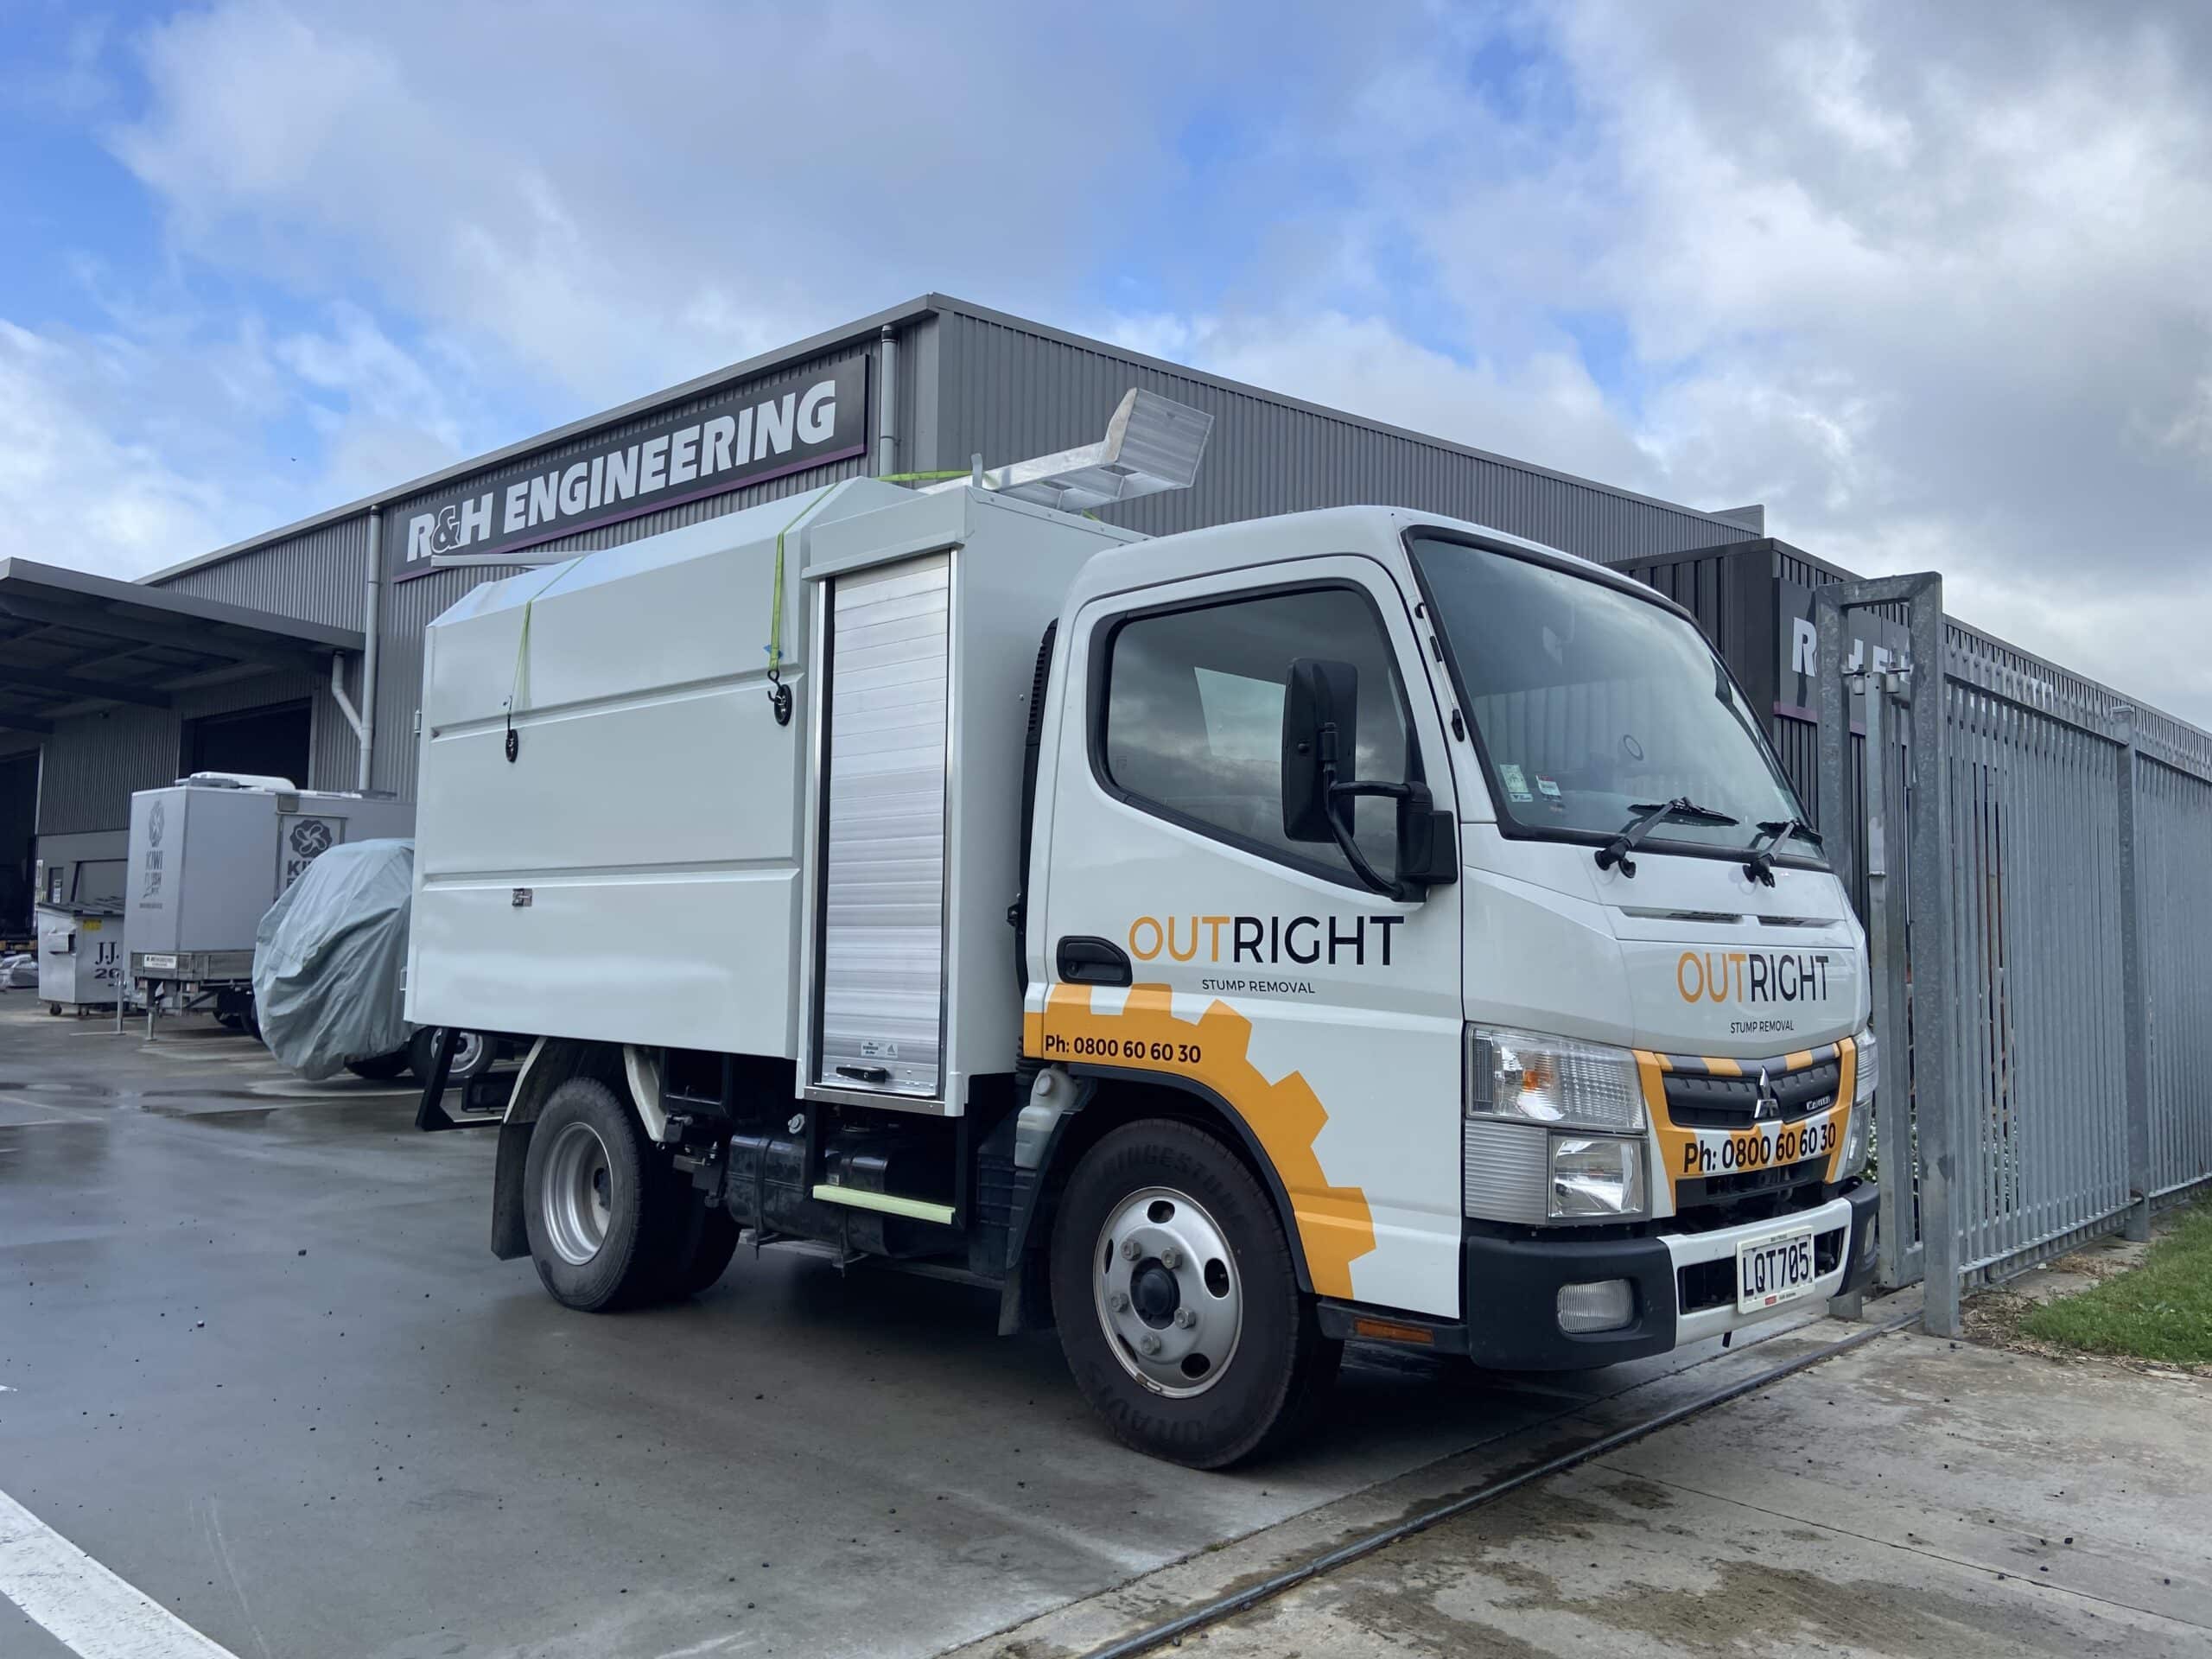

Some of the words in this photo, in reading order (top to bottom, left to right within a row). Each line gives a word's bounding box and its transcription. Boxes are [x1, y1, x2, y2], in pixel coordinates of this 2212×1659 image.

[406, 492, 494, 563] R&H
[503, 379, 836, 533] ENGINEERING
[145, 850, 163, 870] KIWI
[1128, 915, 1405, 965] OUTRIGHT
[1202, 978, 1246, 992] STUMP
[1249, 980, 1315, 995] REMOVAL
[1676, 951, 1830, 1003] OUTRIGHT
[1045, 1034, 1071, 1054] Ph:
[1074, 1036, 1119, 1058] 0800
[1122, 1040, 1147, 1060] 60
[1150, 1042, 1174, 1062] 60
[1177, 1044, 1202, 1065] 30
[1730, 1020, 1758, 1034] STUMP
[1759, 1020, 1795, 1033] REMOVAL
[1684, 1139, 1717, 1173] Ph:
[1721, 1135, 1771, 1169] 0800
[1775, 1132, 1796, 1162] 60
[1799, 1127, 1819, 1157] 60
[1820, 1122, 1837, 1152] 30
[1742, 1241, 1809, 1297] LQT705
